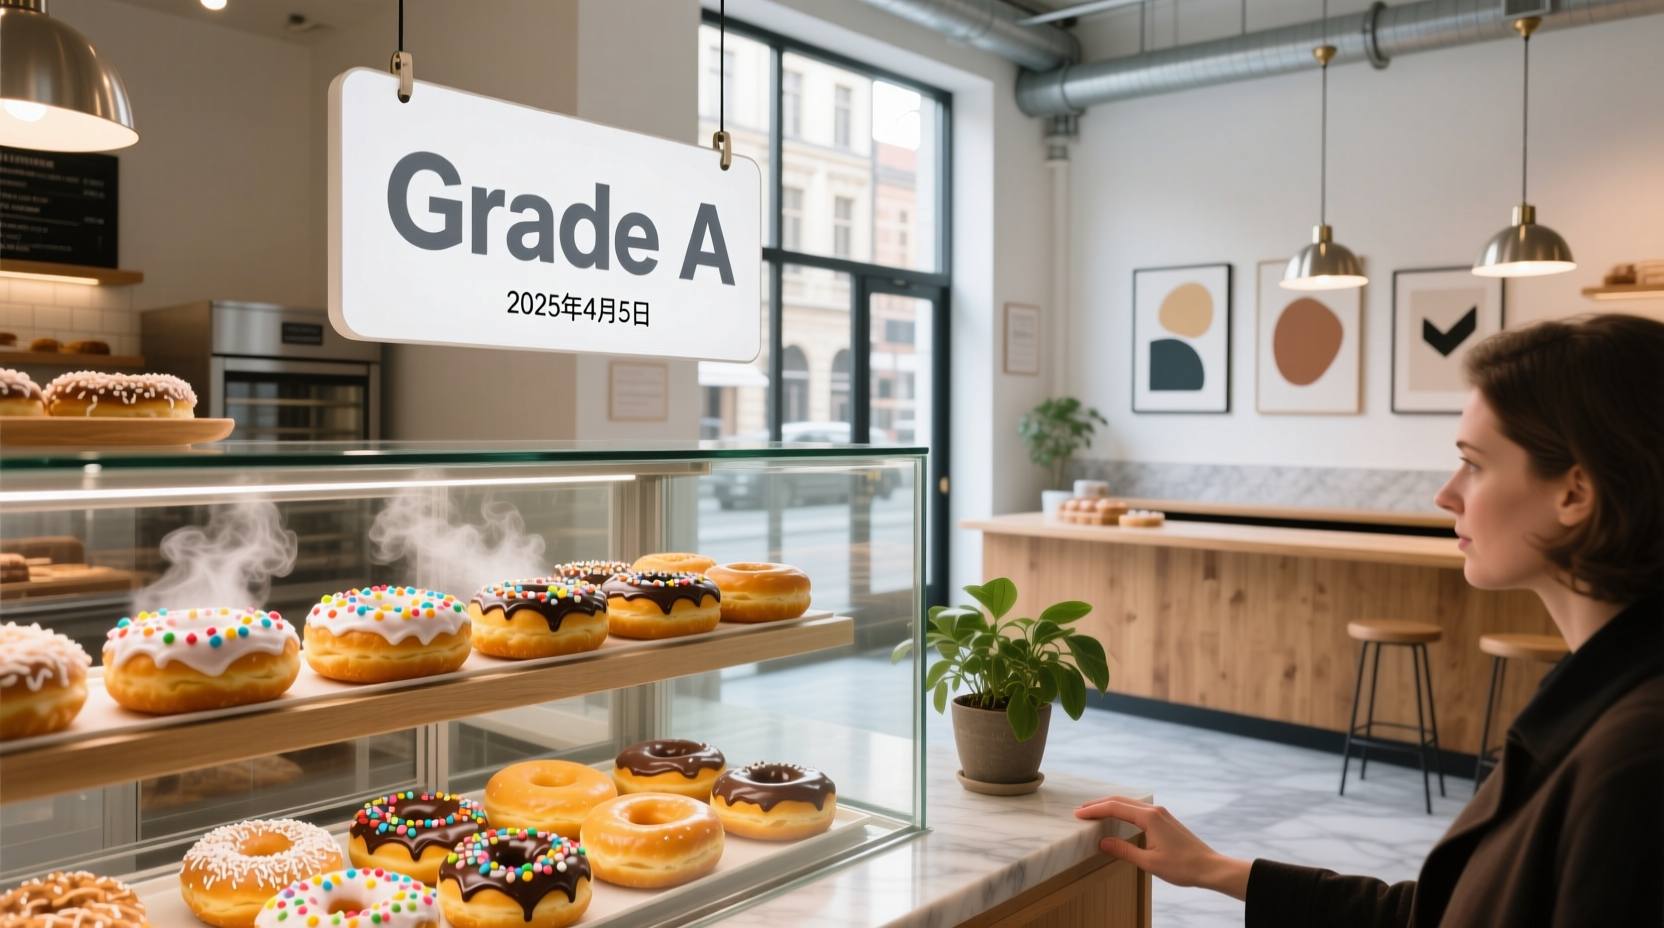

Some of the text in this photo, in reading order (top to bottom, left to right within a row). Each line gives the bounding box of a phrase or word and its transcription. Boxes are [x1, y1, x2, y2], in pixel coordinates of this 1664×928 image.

[387, 150, 736, 286] Grade A
[507, 290, 649, 327] 2025年4月5日
